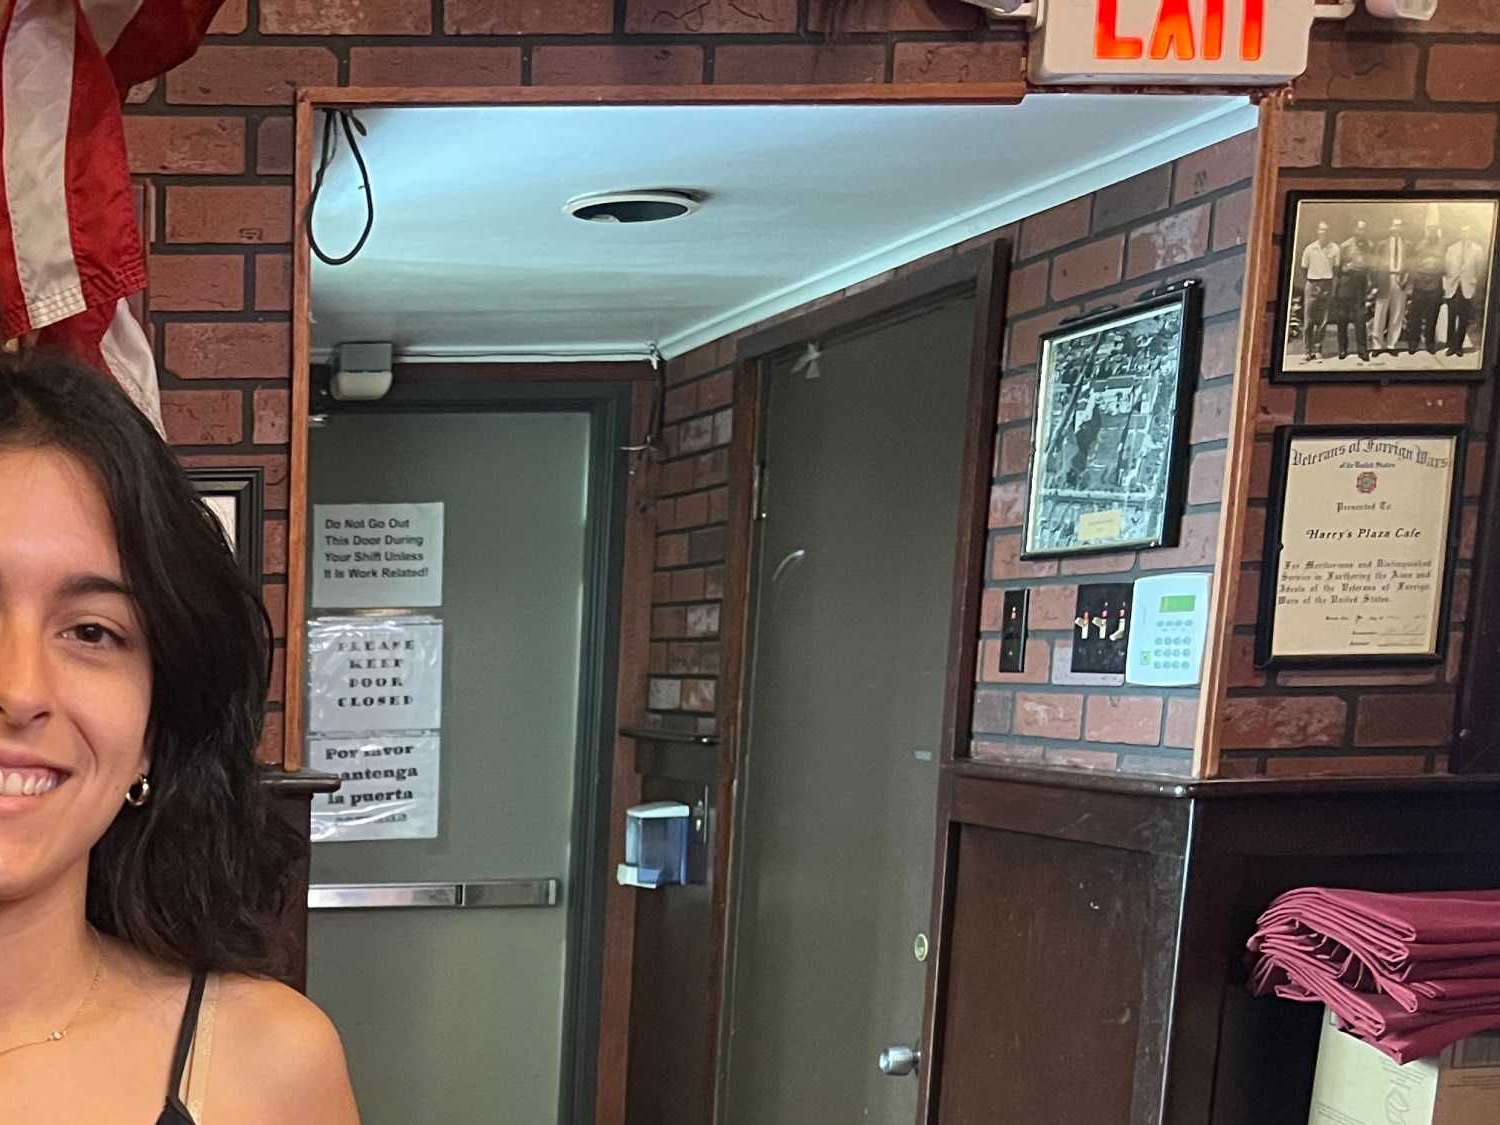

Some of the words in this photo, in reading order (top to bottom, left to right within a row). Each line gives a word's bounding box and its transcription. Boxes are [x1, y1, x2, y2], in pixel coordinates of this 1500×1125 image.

[1292, 445, 1346, 466] Veterans
[1348, 441, 1360, 454] of
[1361, 437, 1413, 461] Foreign
[1412, 445, 1448, 468] Wars
[1336, 501, 1376, 513] Presented
[1379, 501, 1392, 510] To
[325, 519, 341, 529] Do
[344, 519, 365, 529] Not
[368, 518, 385, 528] Go
[388, 518, 410, 528] Out
[1306, 529, 1352, 540] Harry's
[1357, 528, 1390, 538] Plaza
[1395, 527, 1421, 538] Cafe
[325, 535, 349, 545] This
[352, 535, 381, 545] Door
[384, 535, 424, 547] During
[325, 552, 351, 562] Your
[354, 552, 381, 561] Shift
[384, 551, 424, 561] Unless
[1284, 560, 1300, 569] For
[1358, 560, 1372, 568] and
[323, 569, 331, 578] It
[335, 569, 345, 578] Is
[348, 568, 378, 578] Work
[381, 567, 429, 578] Related!
[1281, 572, 1311, 581] Service
[1375, 571, 1386, 579] the
[1416, 570, 1431, 578] and
[1279, 584, 1305, 593] Ideals
[1310, 584, 1318, 592] of
[1323, 584, 1335, 592] the
[1341, 583, 1376, 592] Veterans
[1381, 583, 1390, 591] of
[1397, 582, 1430, 592] Foreign
[1277, 596, 1299, 605] Wars
[1303, 595, 1311, 604] of
[1315, 595, 1326, 604] the
[1331, 595, 1358, 604] United
[349, 658, 403, 669] KEEP
[349, 677, 404, 688] DOOR
[337, 695, 414, 707] CLOSED
[325, 748, 358, 760] Por
[362, 745, 414, 757] avor
[340, 767, 418, 781] antenga
[327, 793, 345, 804] la
[350, 788, 414, 807] puerta
